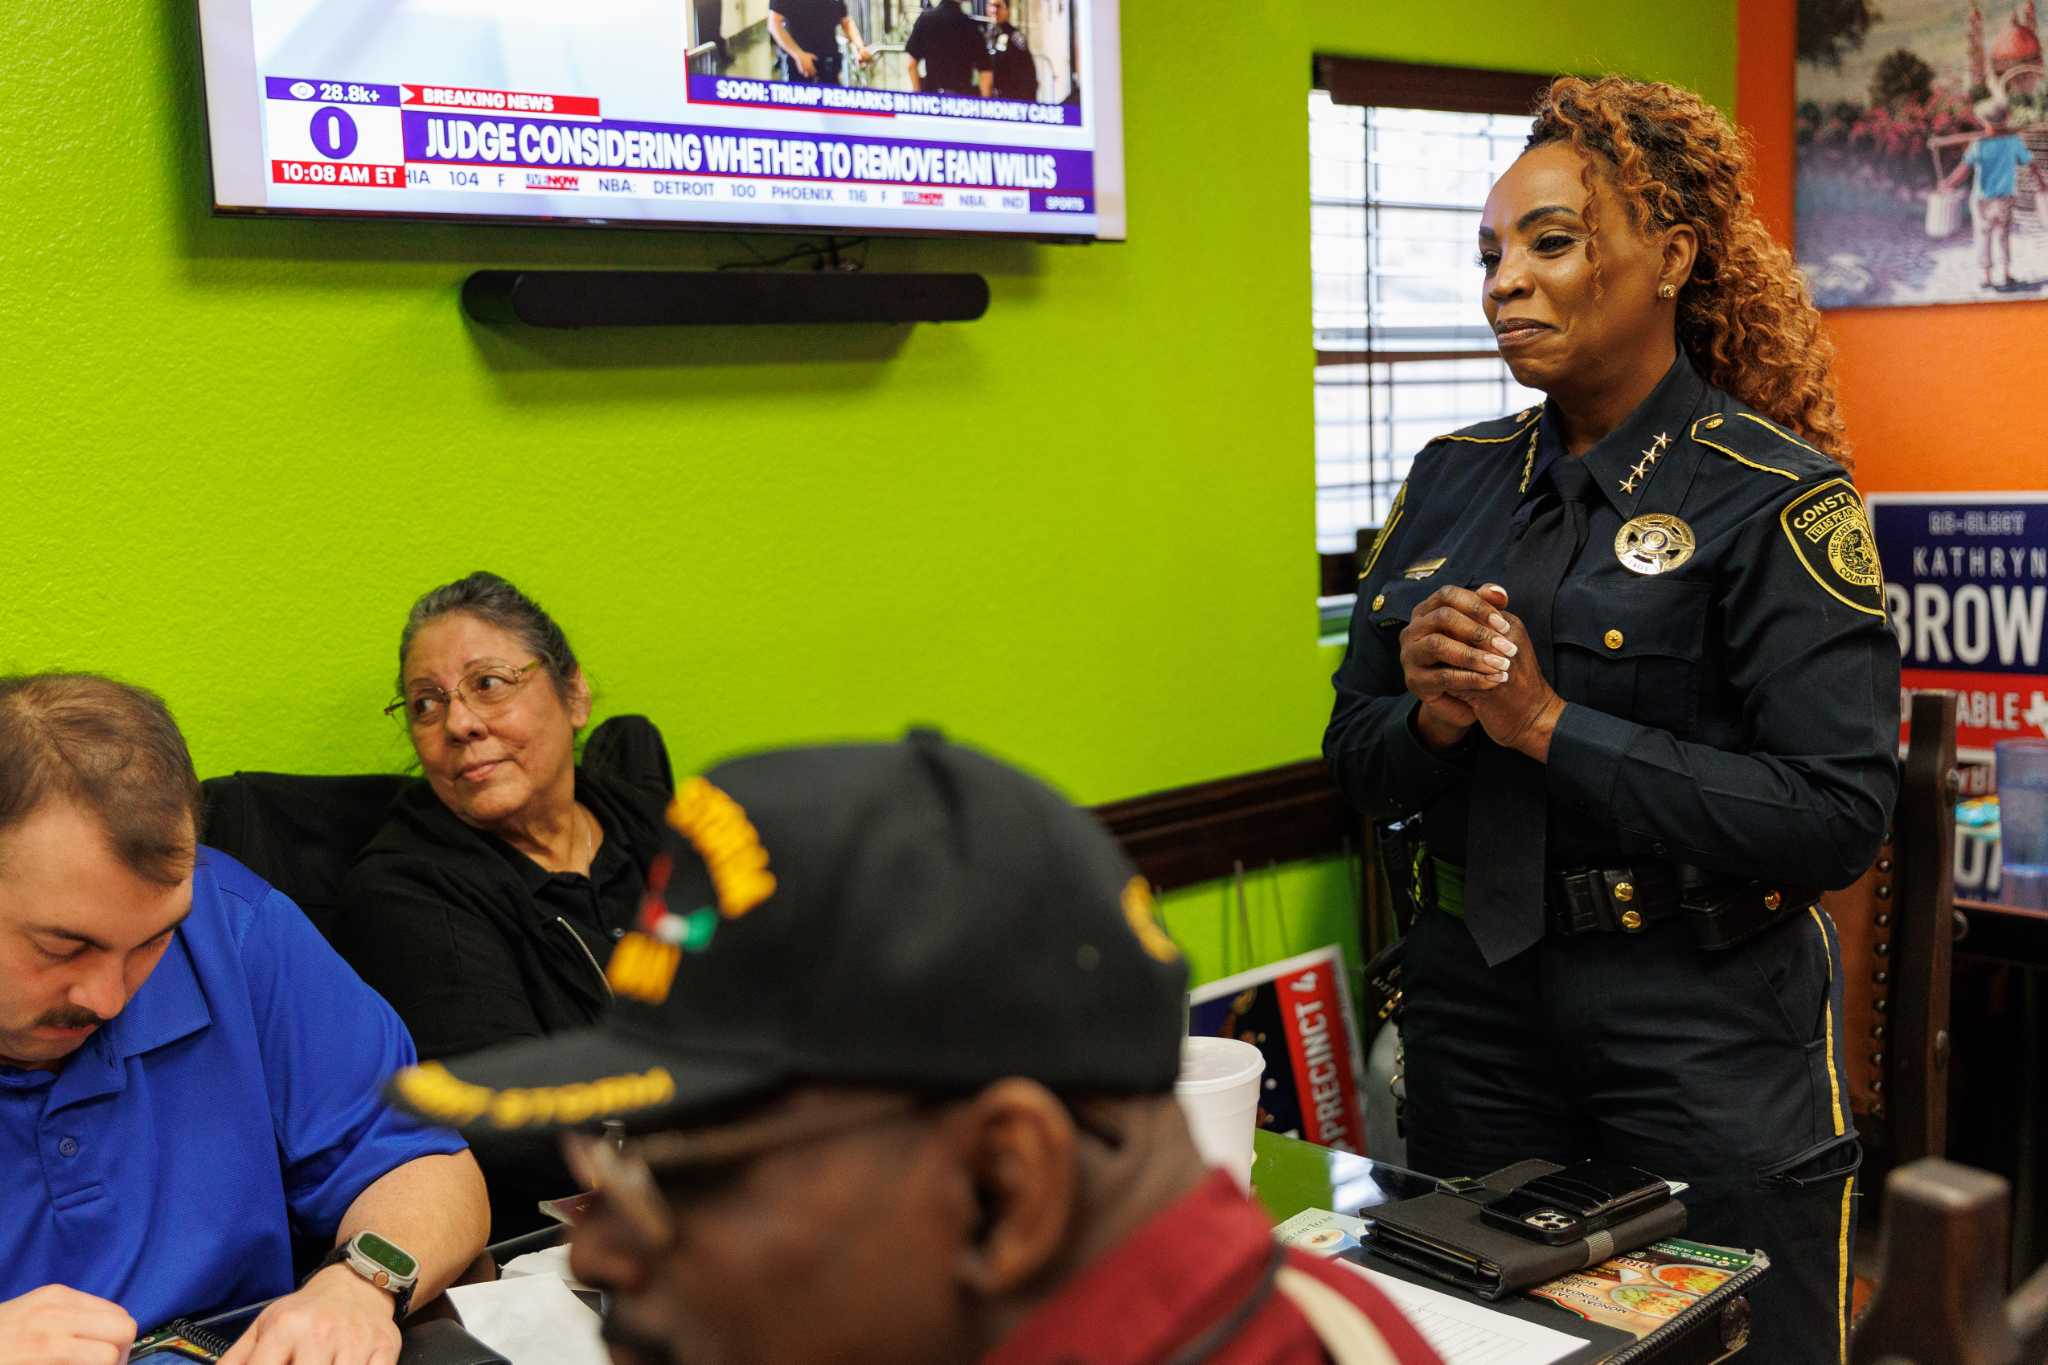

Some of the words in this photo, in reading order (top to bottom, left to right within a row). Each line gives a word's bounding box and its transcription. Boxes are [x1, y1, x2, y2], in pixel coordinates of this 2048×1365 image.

[320, 83, 380, 103] 28.8k+
[422, 88, 505, 109] BREAKING
[508, 94, 554, 111] NEWS
[716, 79, 769, 101] SOON:
[769, 84, 822, 105] TRUMP
[822, 88, 893, 111] REMARKS
[894, 93, 910, 113] IN
[911, 95, 941, 115] NYC
[941, 97, 979, 118] HUSH
[981, 101, 1028, 121] MONEY
[1028, 104, 1064, 124] CASE
[426, 118, 517, 162] JUDGE
[518, 123, 702, 171] CONSIDERING
[702, 135, 819, 177] WHETHER
[818, 142, 851, 178] TO
[852, 144, 945, 184] REMOVE
[945, 148, 993, 186] FANI
[282, 163, 336, 182] 10:08
[338, 165, 370, 184] AM
[375, 167, 397, 185] ET
[449, 170, 479, 186] 104
[498, 174, 505, 185] F
[654, 180, 714, 196] DETROIT
[731, 184, 756, 199] 100
[772, 186, 832, 201] PHOENIX
[1046, 196, 1085, 211] SPORTS
[1810, 518, 1834, 537] TEXAS
[1928, 510, 2027, 536] RE-ELECT
[1912, 546, 2048, 578] KATHRYN
[1840, 567, 1875, 584] COUNTY
[1295, 1001, 1348, 1145] PRECINCT
